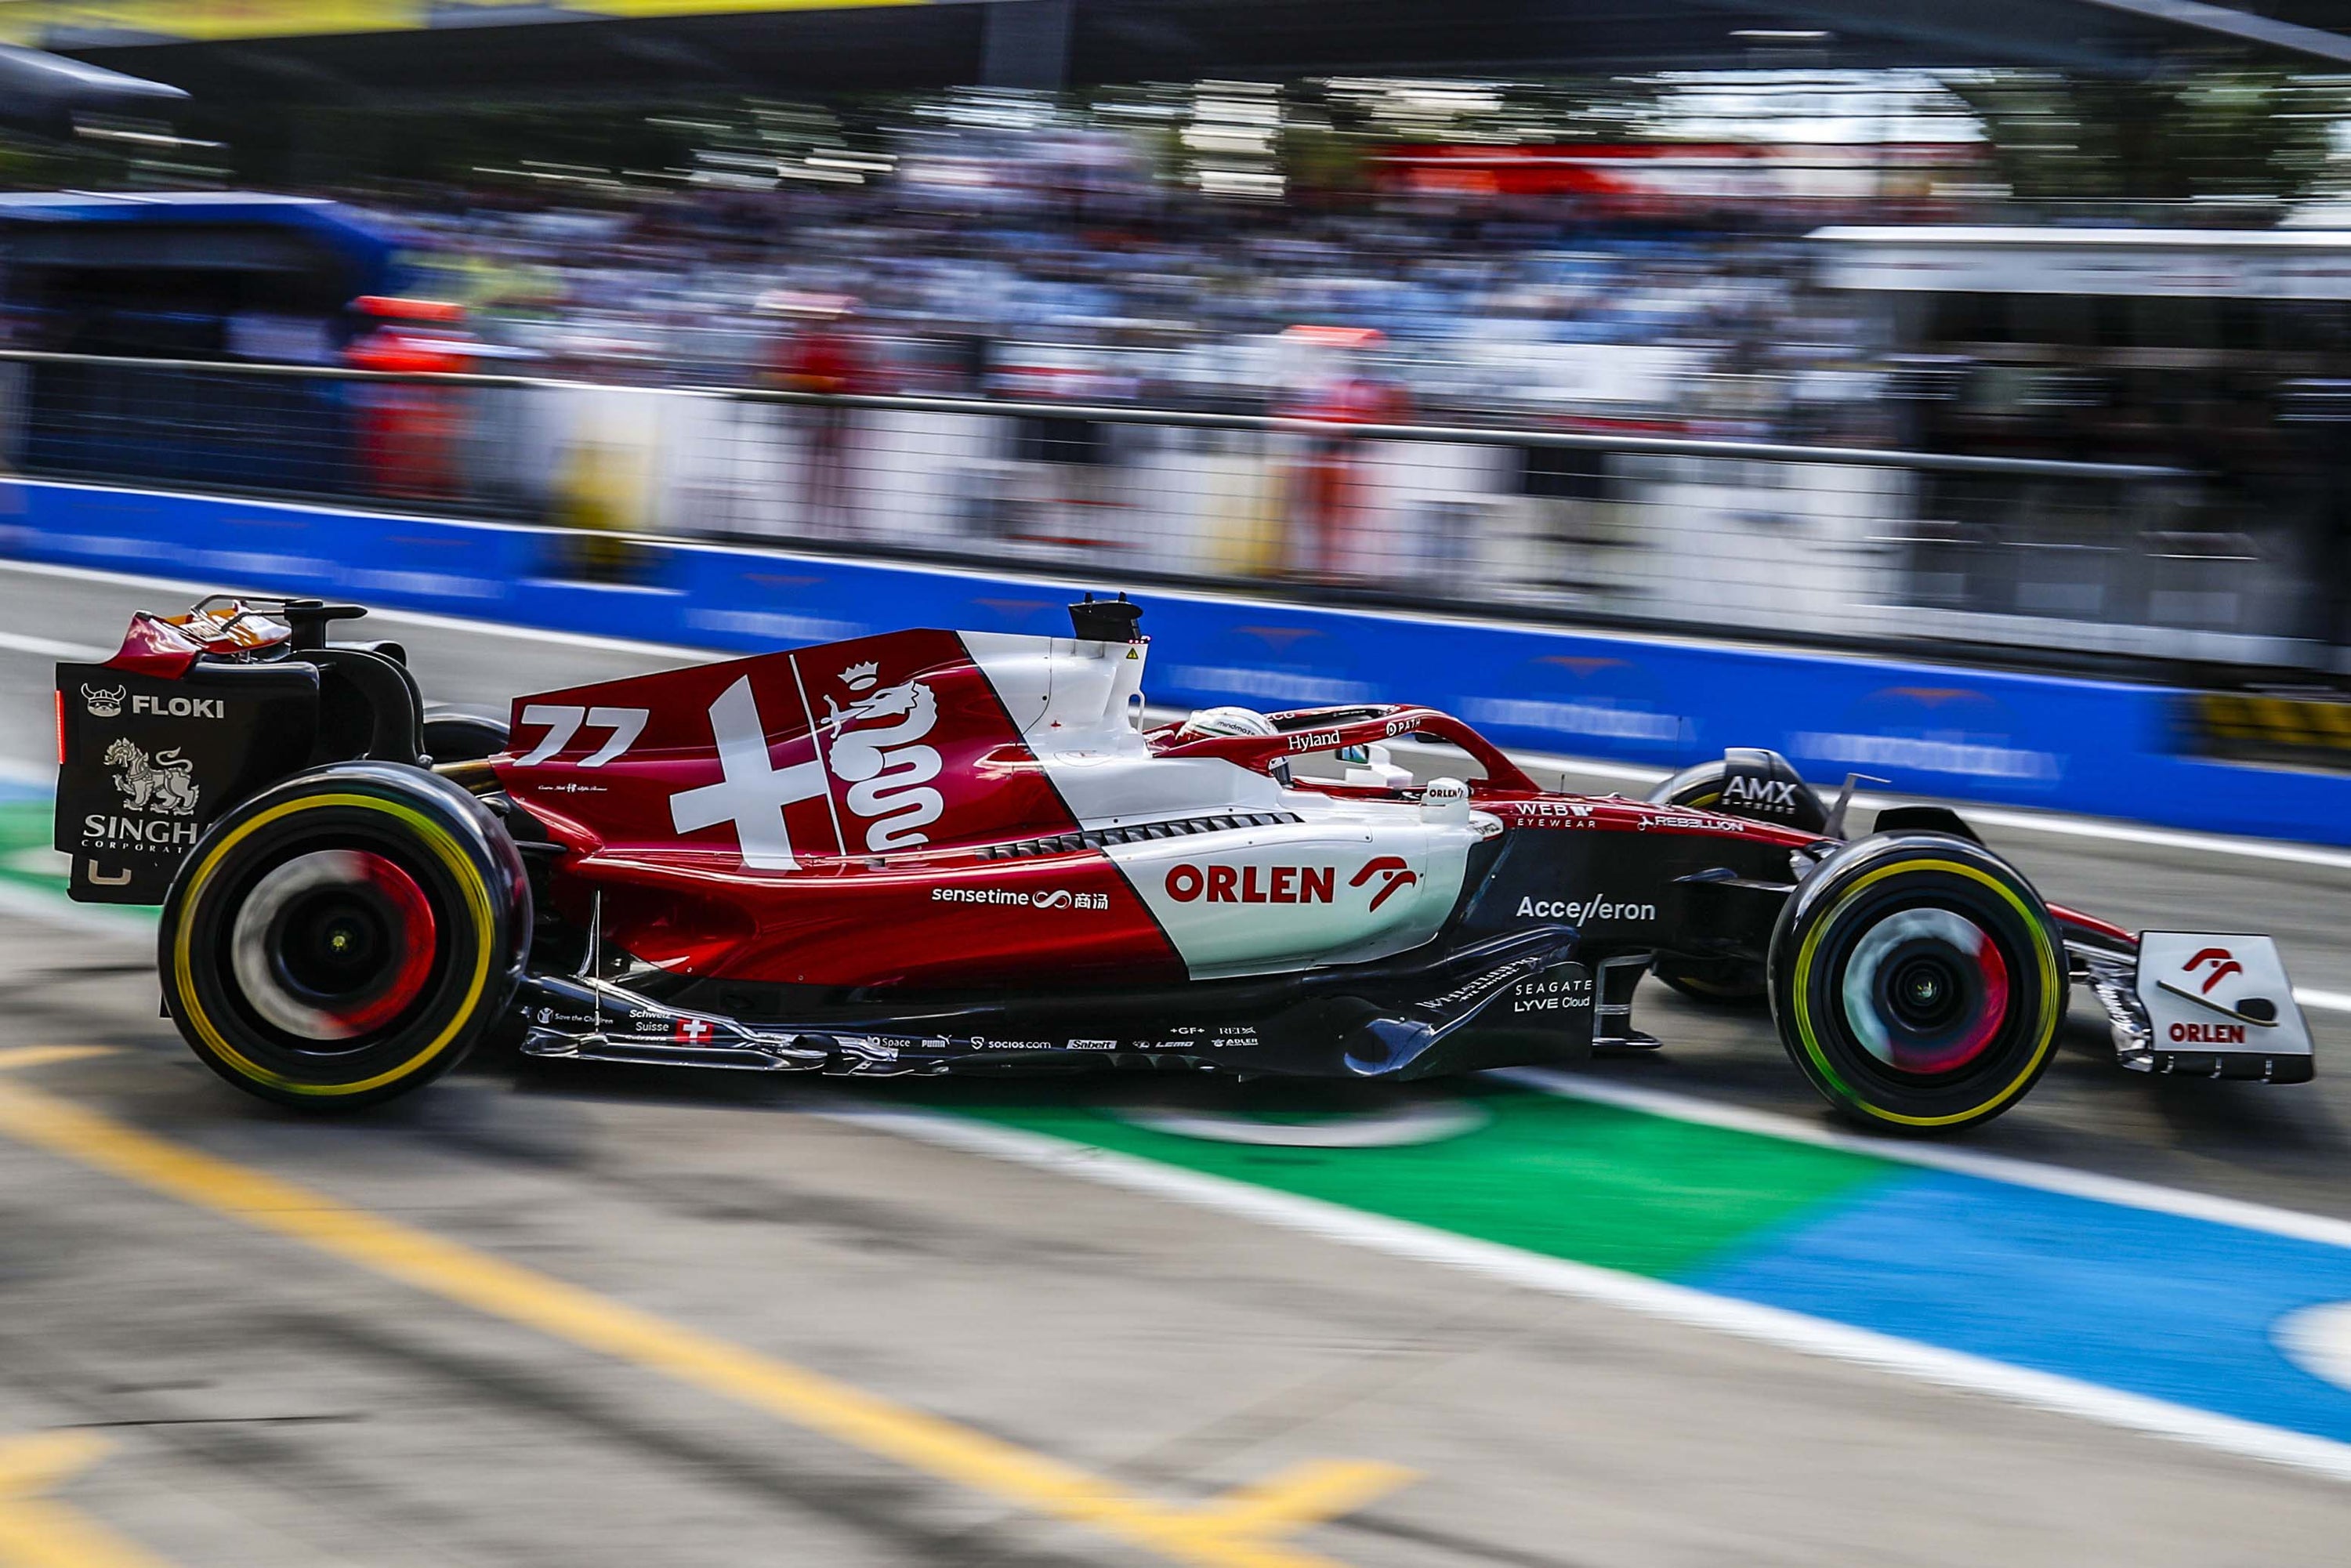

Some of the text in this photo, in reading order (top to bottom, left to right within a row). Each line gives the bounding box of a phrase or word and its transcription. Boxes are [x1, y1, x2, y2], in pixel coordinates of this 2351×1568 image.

[132, 695, 224, 719] FLOKI
[1398, 719, 1421, 733] PATH
[513, 704, 649, 767] 77
[1288, 730, 1341, 751] Hyland
[1429, 789, 1458, 798] ORLEN
[1722, 775, 1798, 806] AMX
[1515, 803, 1569, 816] WEB
[83, 814, 213, 844] SINGH
[1517, 818, 1596, 828] EYEWEAR
[1165, 864, 1335, 903] ORLEN
[932, 888, 1029, 905] sensetime
[1074, 893, 1108, 910] 商汤
[1515, 980, 1592, 995] SEAGATE
[1514, 996, 1590, 1012] LYVE Cloud
[583, 1016, 614, 1024] Chren
[635, 1021, 669, 1031] Suisse
[2169, 1023, 2246, 1044] ORLEN
[882, 1037, 910, 1047] Space
